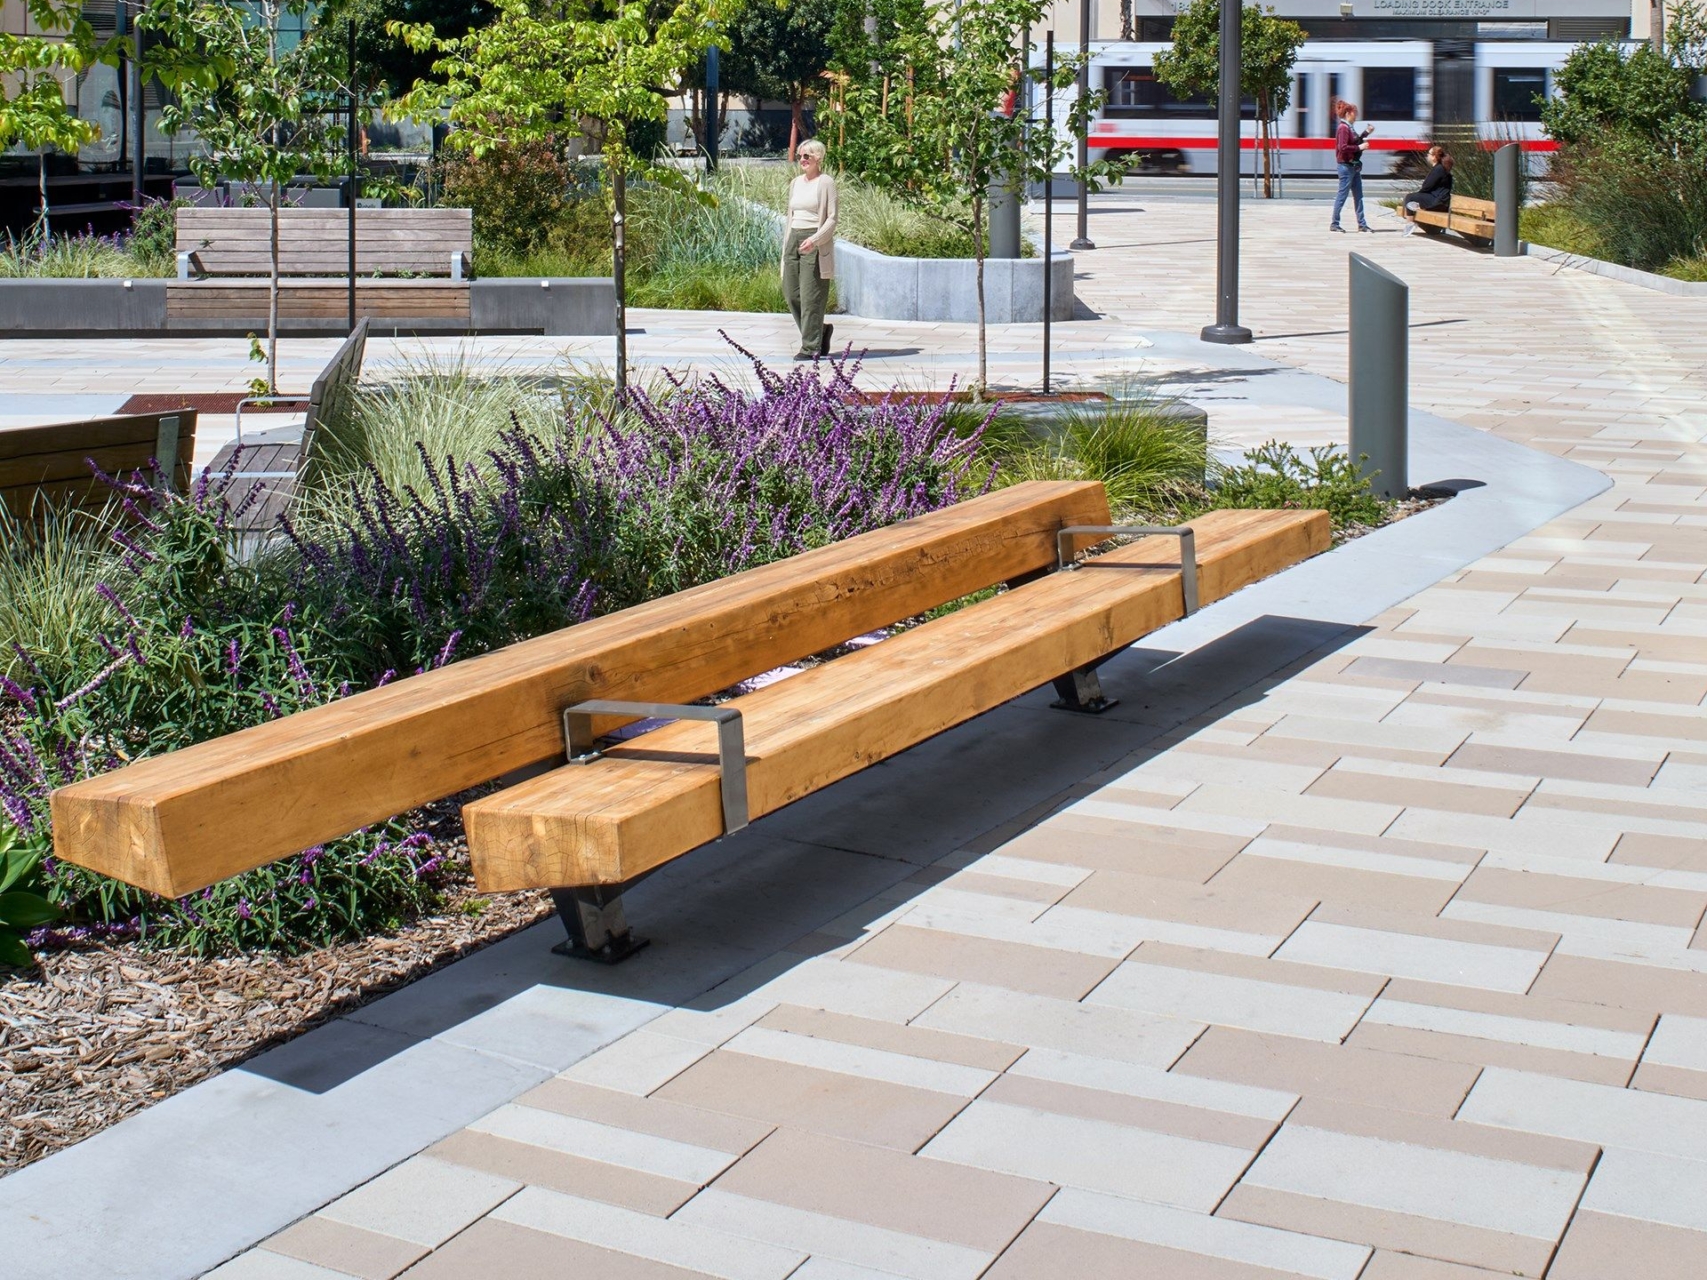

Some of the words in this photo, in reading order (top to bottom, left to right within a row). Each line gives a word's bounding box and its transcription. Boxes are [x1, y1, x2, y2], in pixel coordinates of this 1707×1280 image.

[1373, 0, 1419, 9] LOADING
[1421, 0, 1451, 9] DOCK
[1453, 0, 1509, 9] ENTRANCE
